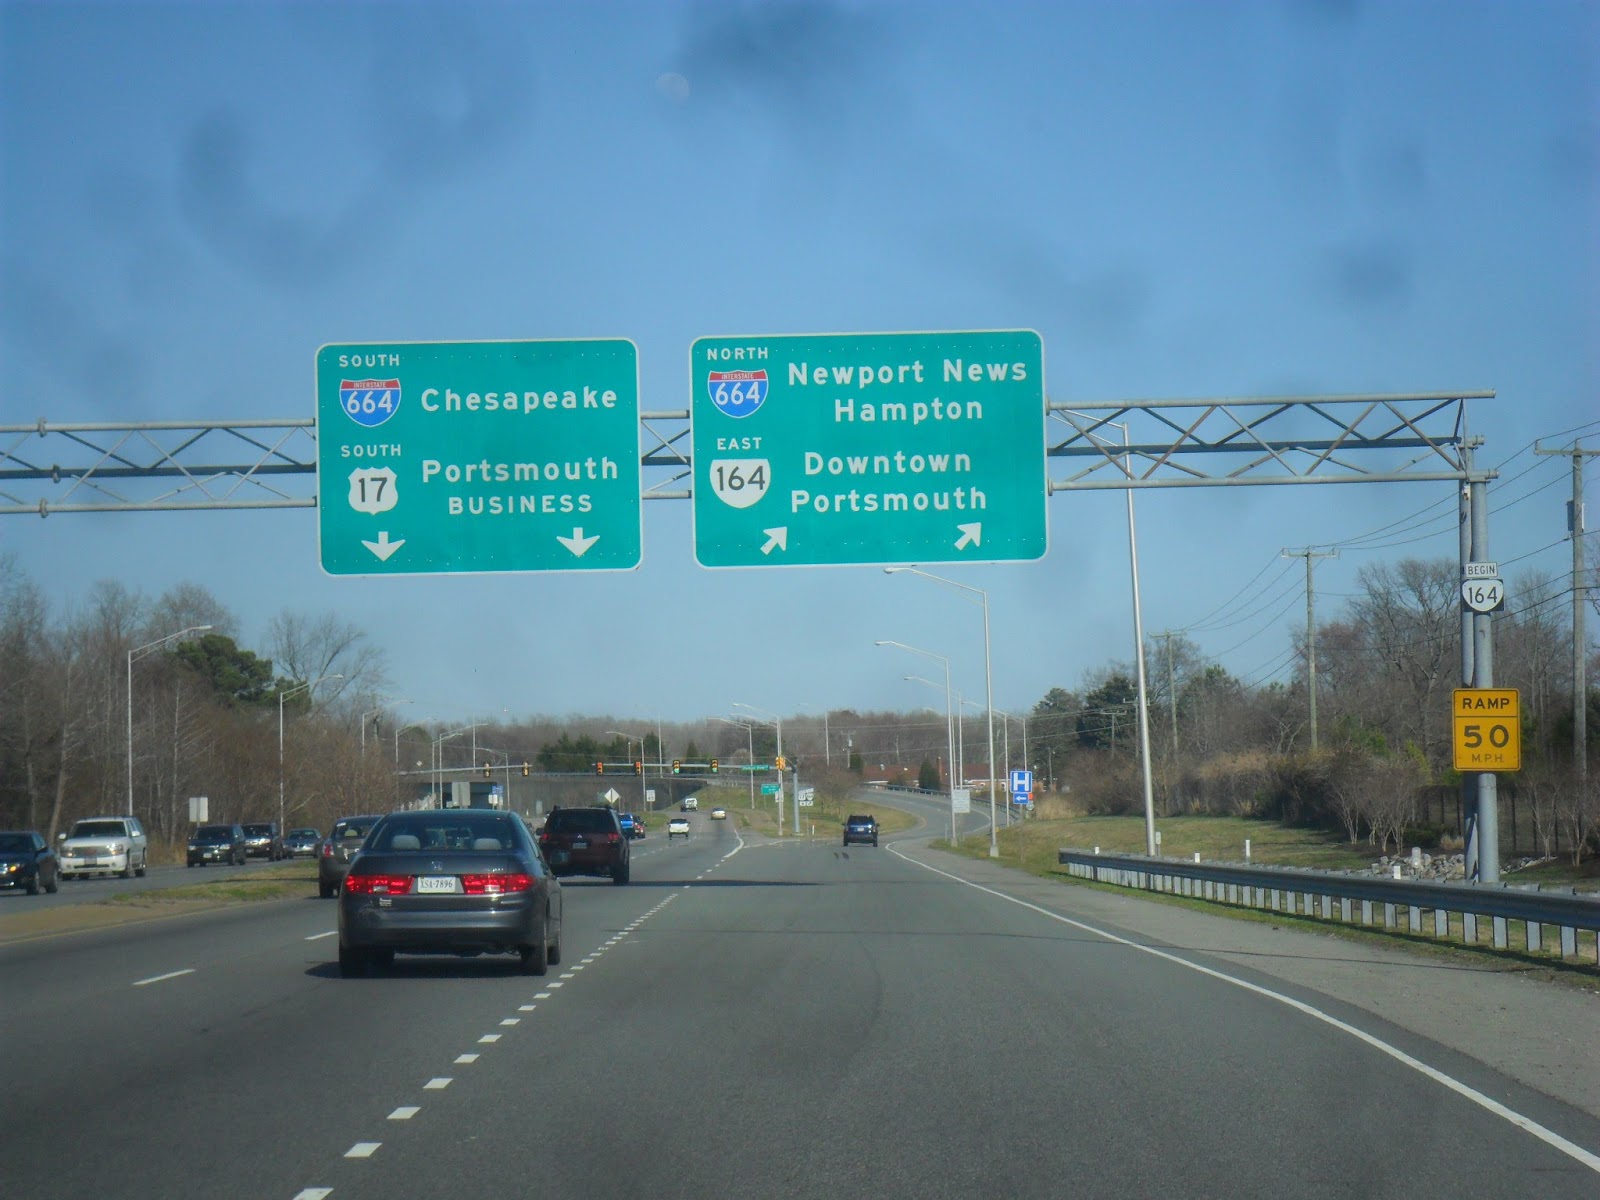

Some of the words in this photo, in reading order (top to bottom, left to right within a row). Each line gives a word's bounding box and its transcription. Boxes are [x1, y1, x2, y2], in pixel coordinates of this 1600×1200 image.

[338, 354, 400, 367] SOUTH
[707, 347, 769, 360] NORTH
[721, 372, 754, 380] INTERSTATE
[788, 360, 924, 389] Newport
[943, 358, 1027, 383] News
[346, 390, 392, 413] 664
[420, 386, 618, 414] Chesapeake
[715, 381, 760, 405] 664
[835, 397, 983, 425] Hampton
[340, 444, 401, 457] SOUTH
[717, 437, 762, 450] EAST
[422, 456, 618, 483] Portsmouth
[804, 450, 971, 475] Downtown
[358, 477, 388, 502] 17
[716, 465, 766, 491] 164
[449, 494, 592, 515] BUSINESS
[791, 488, 986, 513] Portsmouth
[1467, 565, 1496, 575] BEGIN
[1468, 586, 1498, 604] 164
[1462, 698, 1510, 710] RAMP
[1463, 724, 1510, 748] 50
[1013, 772, 1030, 792] H
